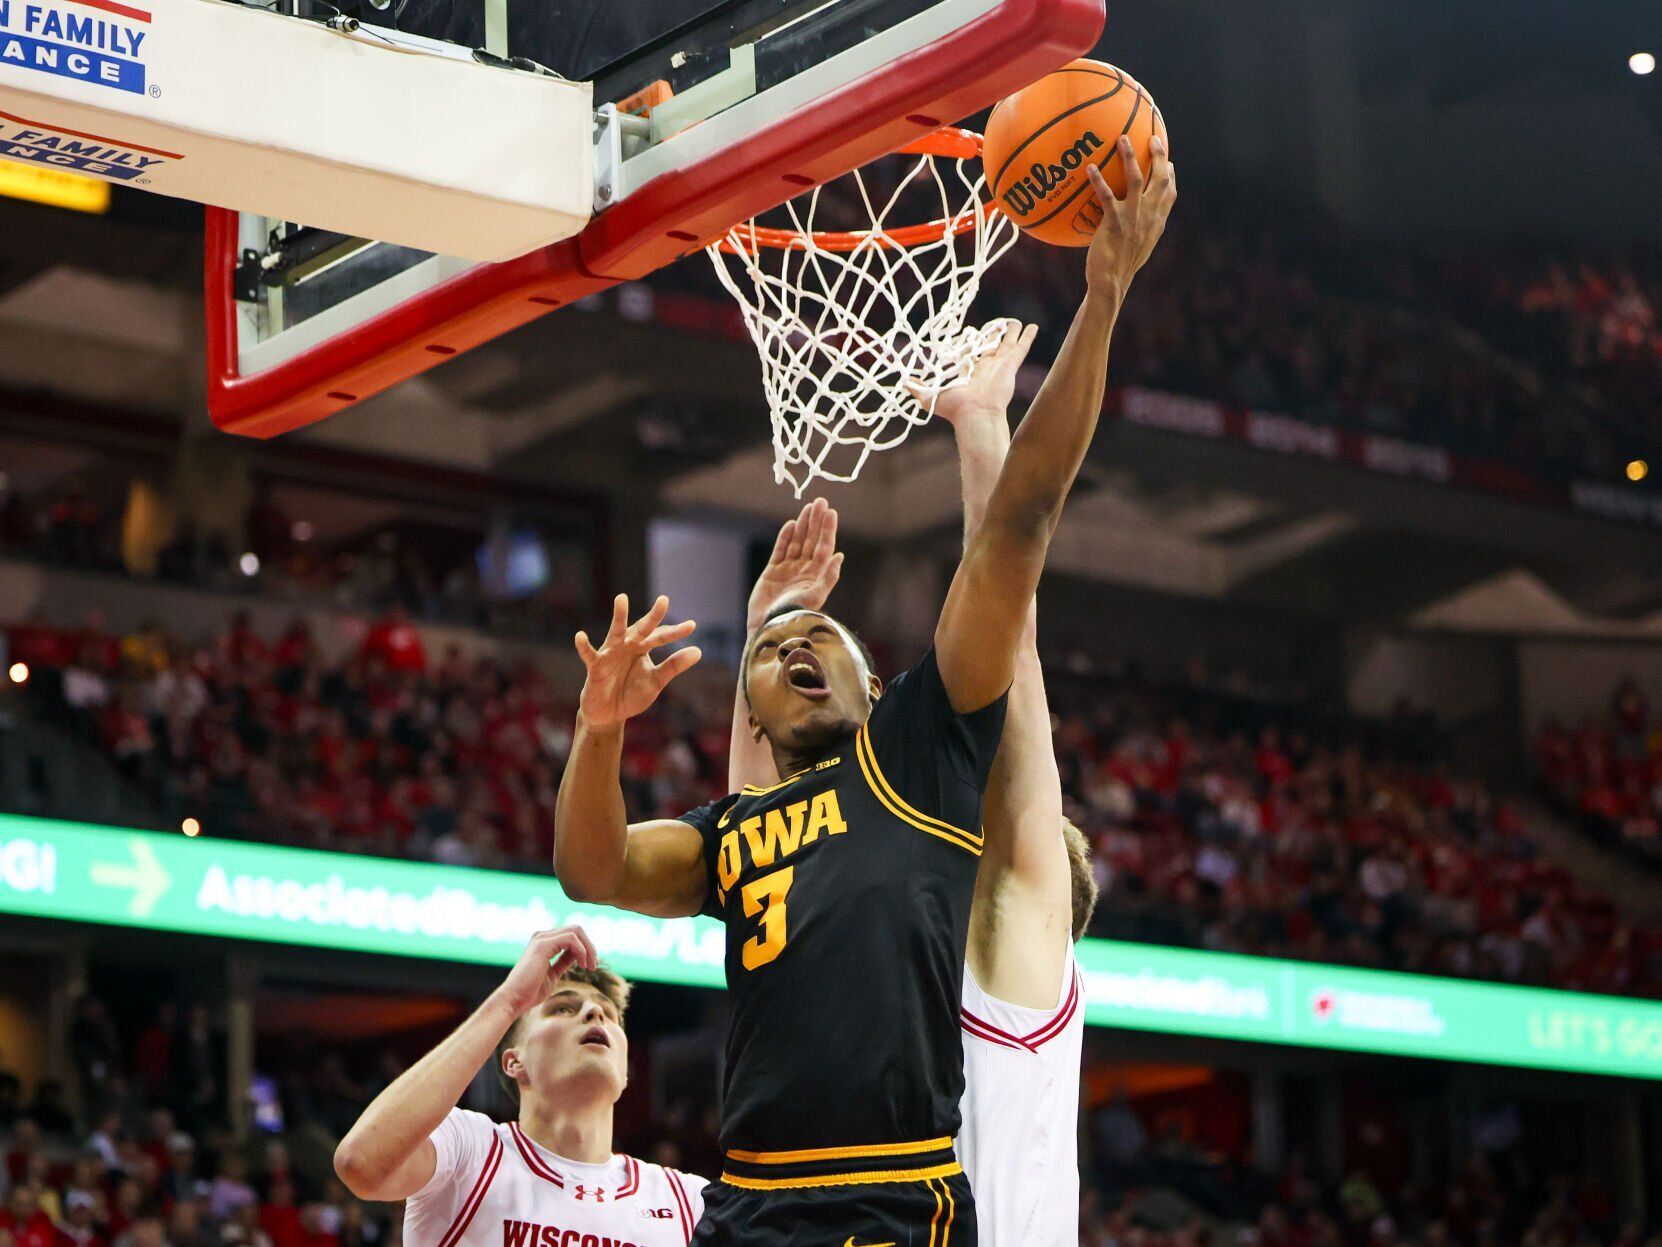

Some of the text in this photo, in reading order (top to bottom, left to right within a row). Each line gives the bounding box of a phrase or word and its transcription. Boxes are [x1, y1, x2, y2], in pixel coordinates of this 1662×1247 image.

[25, 4, 146, 58] FAMILY
[3, 40, 120, 82] ANCE
[7, 146, 113, 173] NCE
[10, 130, 165, 169] FAMILY
[1003, 129, 1105, 216] Wilson
[717, 789, 848, 907] OWA
[741, 865, 794, 971] 3
